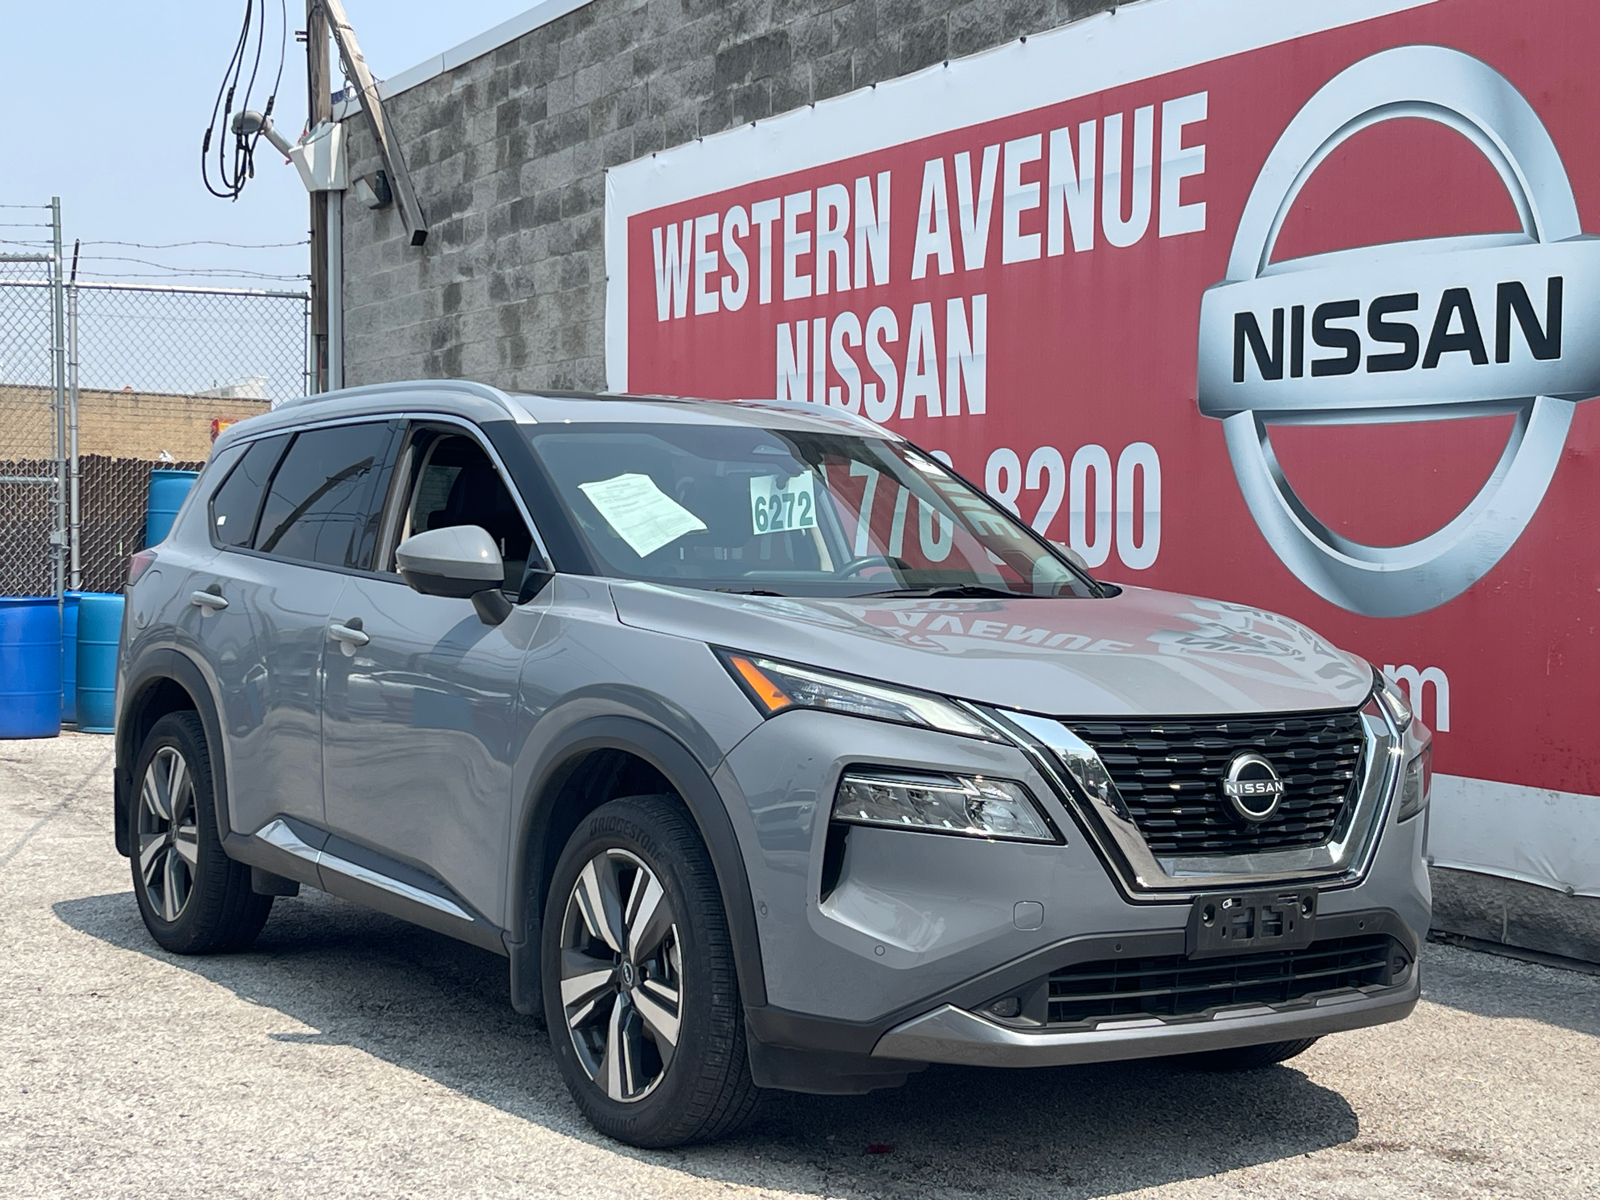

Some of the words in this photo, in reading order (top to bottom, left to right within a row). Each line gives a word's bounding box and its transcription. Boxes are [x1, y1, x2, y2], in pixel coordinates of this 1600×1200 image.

[652, 170, 891, 322] WESTERN
[911, 91, 1208, 280] AVENUE
[777, 293, 987, 423] NISSAN
[1233, 276, 1563, 383] NISSAN
[755, 491, 814, 532] 6272
[1226, 781, 1284, 794] NISSAN
